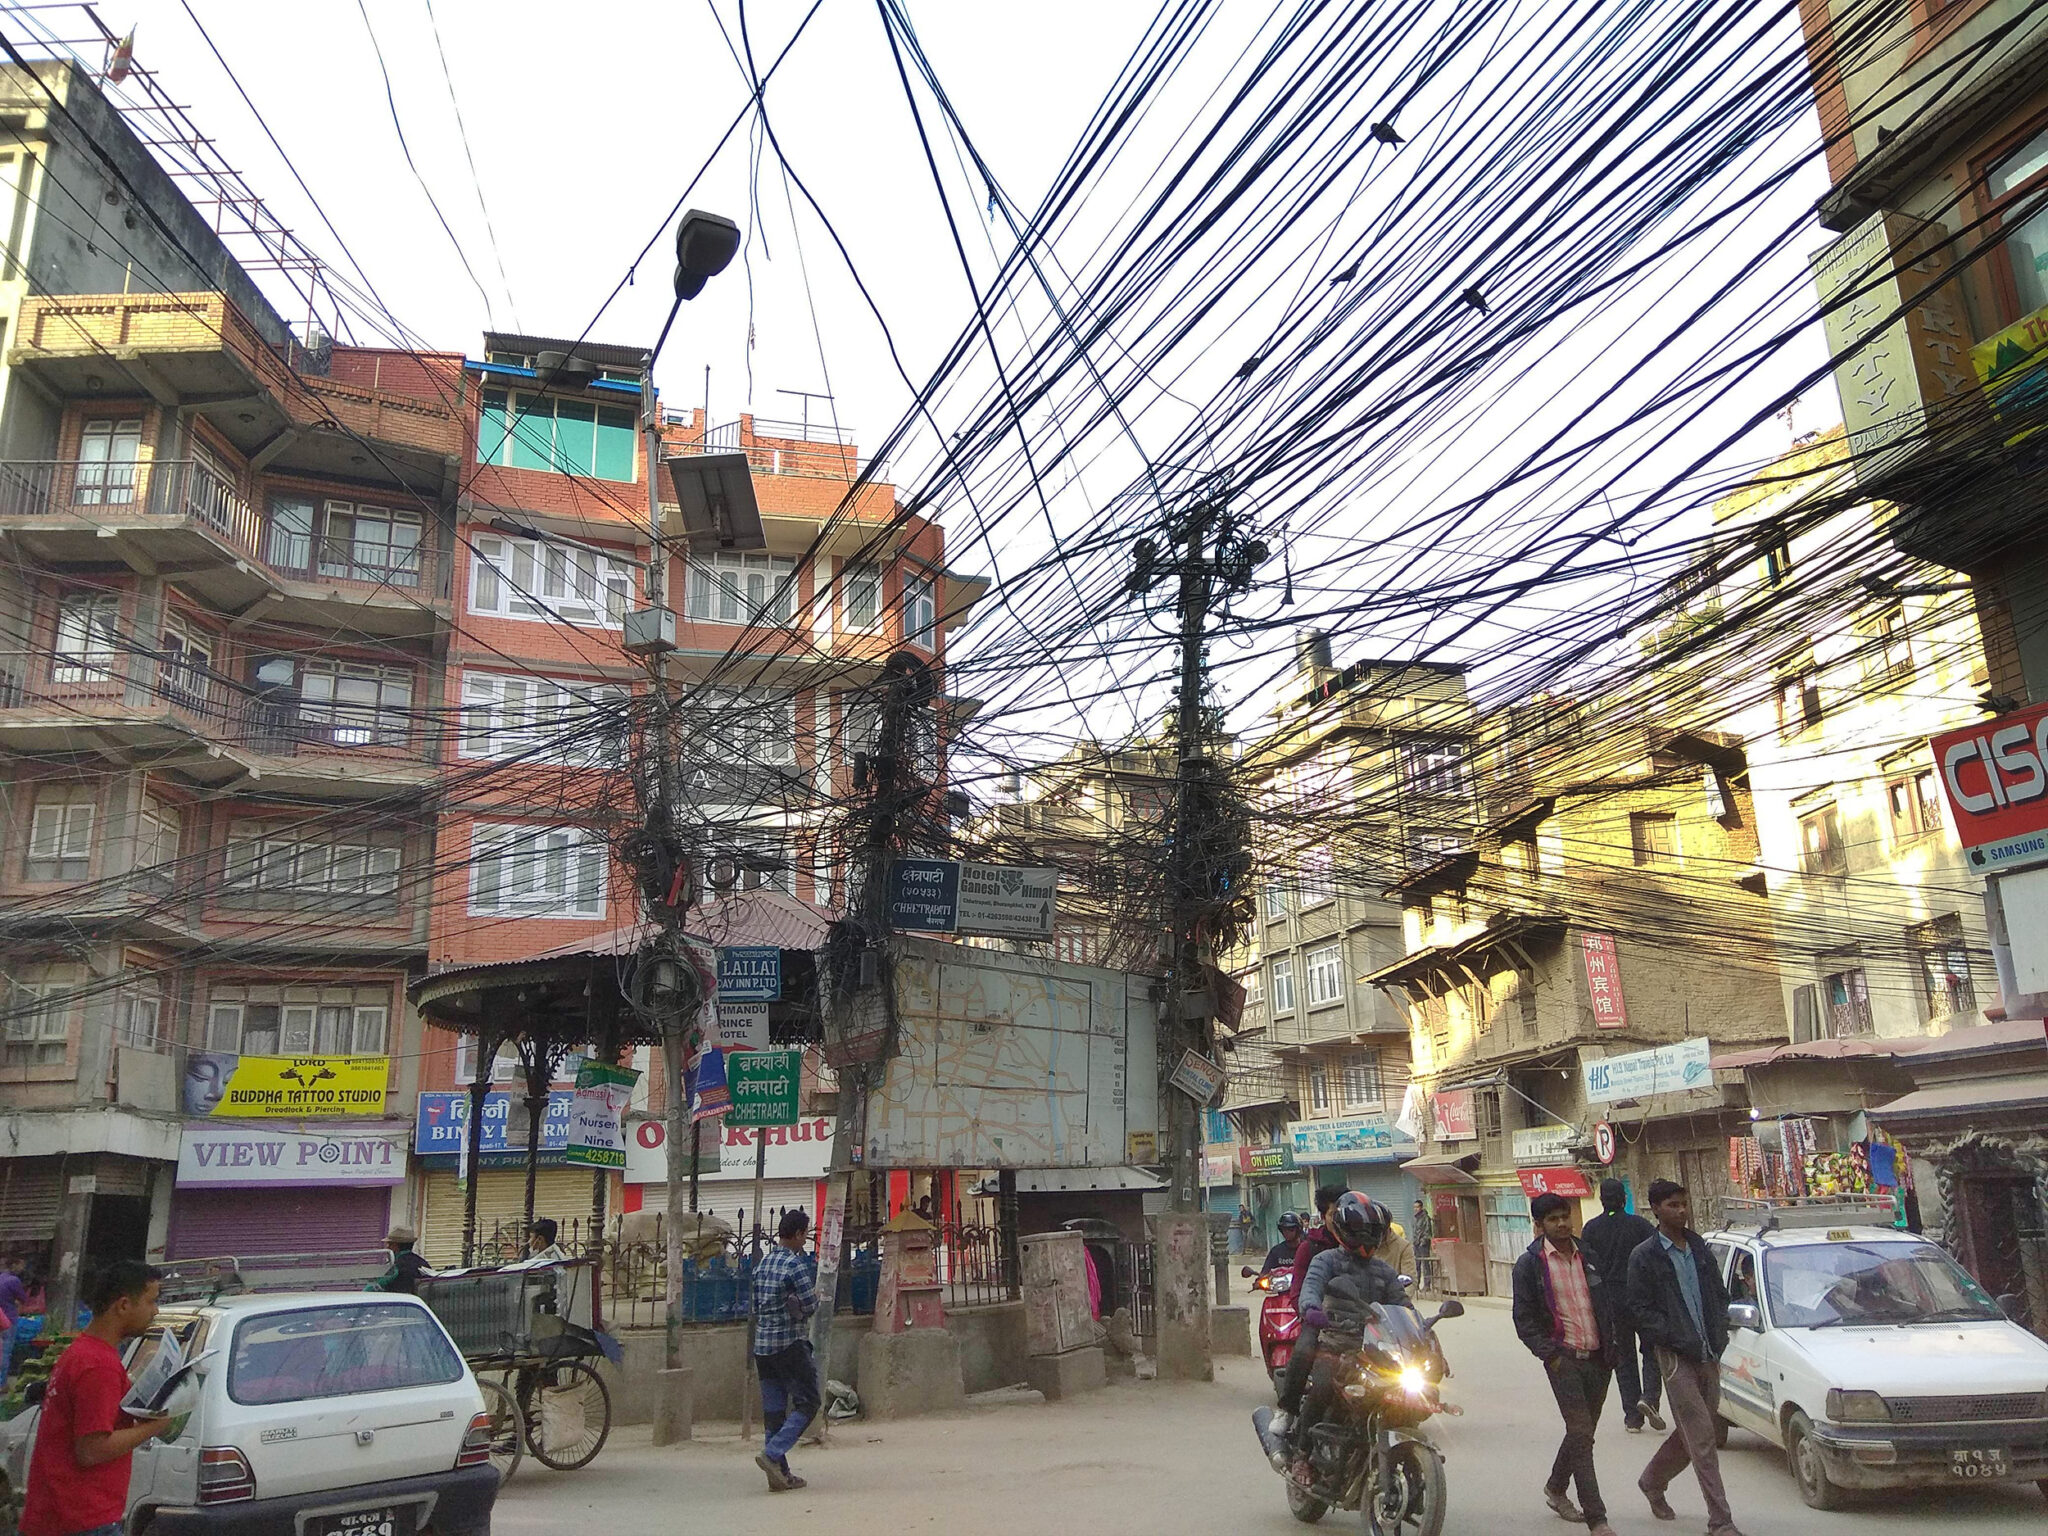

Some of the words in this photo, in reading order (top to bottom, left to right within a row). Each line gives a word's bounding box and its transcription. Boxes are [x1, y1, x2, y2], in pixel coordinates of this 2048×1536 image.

[1990, 838, 2045, 861] SAMSUNG
[962, 866, 1000, 881] Hotel
[960, 879, 1000, 896] Ganesh
[1021, 885, 1053, 898] Himal
[736, 978, 751, 988] INN
[1588, 1064, 1610, 1091] HIS
[736, 1074, 790, 1097] क्षेत्रपाटी
[230, 1090, 283, 1104] BUDDHA
[287, 1090, 335, 1105] TATTOO
[338, 1090, 382, 1103] STUDIO
[265, 1106, 304, 1114] Dreadlock
[314, 1106, 346, 1114] Piercing
[735, 1102, 790, 1120] CHHETRAPATI
[584, 1134, 614, 1147] Nine
[193, 1141, 287, 1167] VIEW
[296, 1140, 399, 1166] POINT
[585, 1149, 625, 1165] 4258718
[1251, 1155, 1263, 1167] ON
[1264, 1154, 1283, 1167] HIRE
[1831, 1231, 1849, 1239] TAXI
